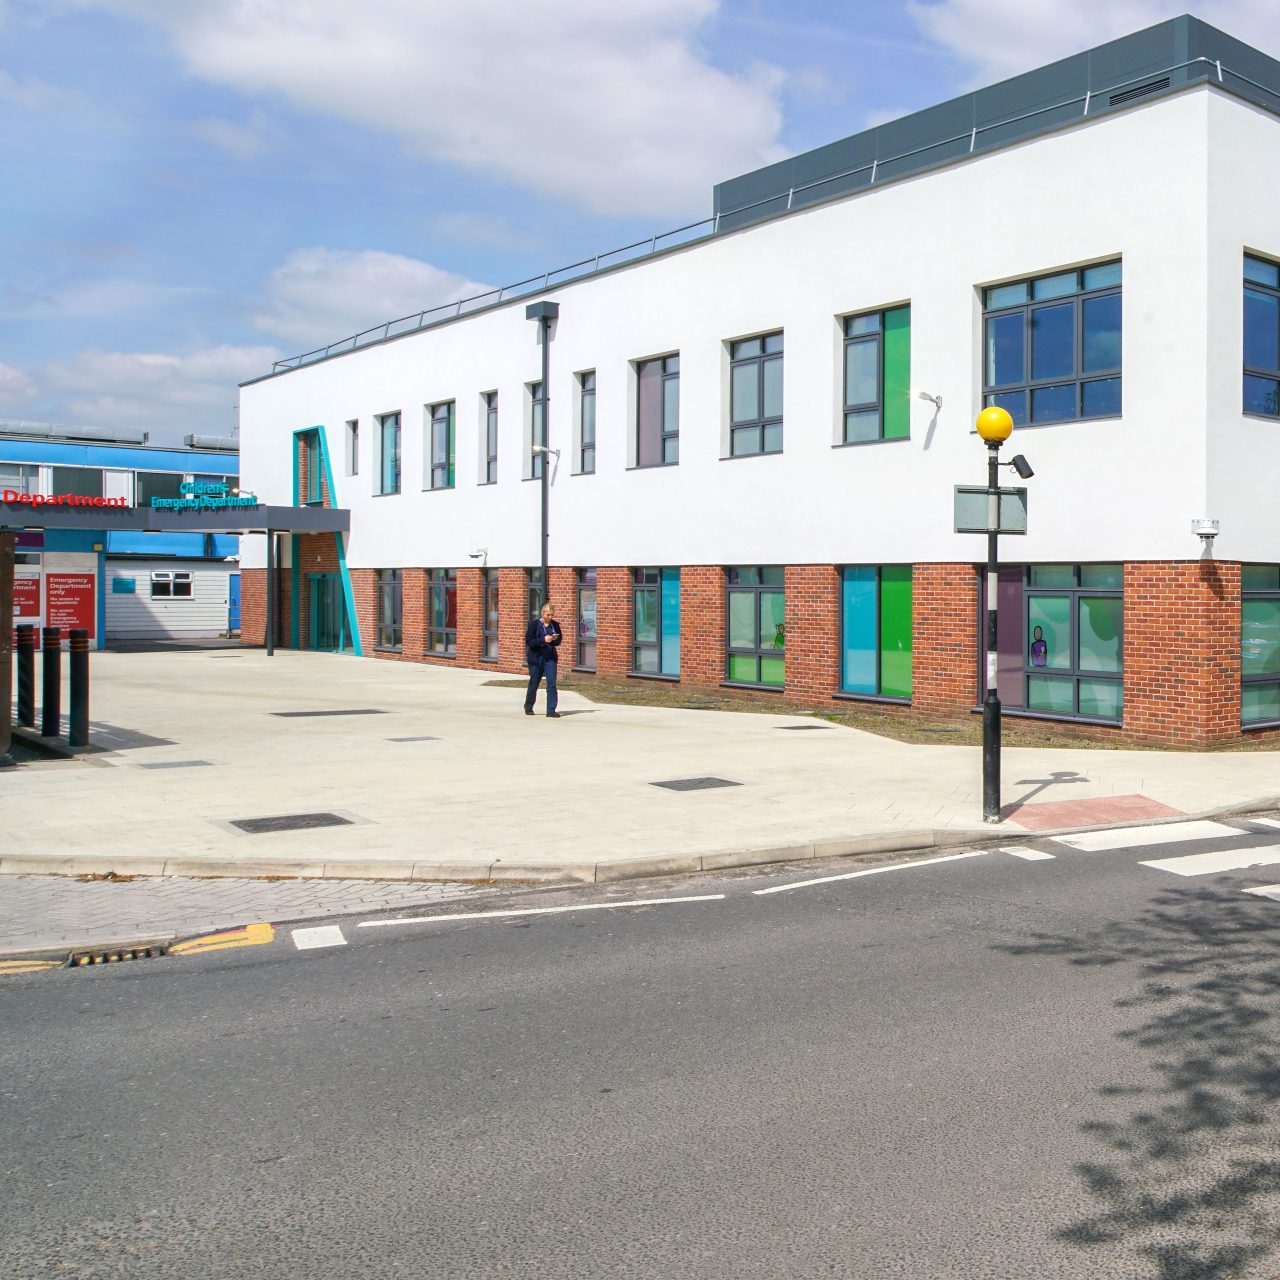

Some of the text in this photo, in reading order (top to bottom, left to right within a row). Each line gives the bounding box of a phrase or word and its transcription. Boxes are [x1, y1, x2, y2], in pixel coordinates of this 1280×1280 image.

[3, 489, 128, 507] Department
[151, 496, 257, 510] Emergency Department
